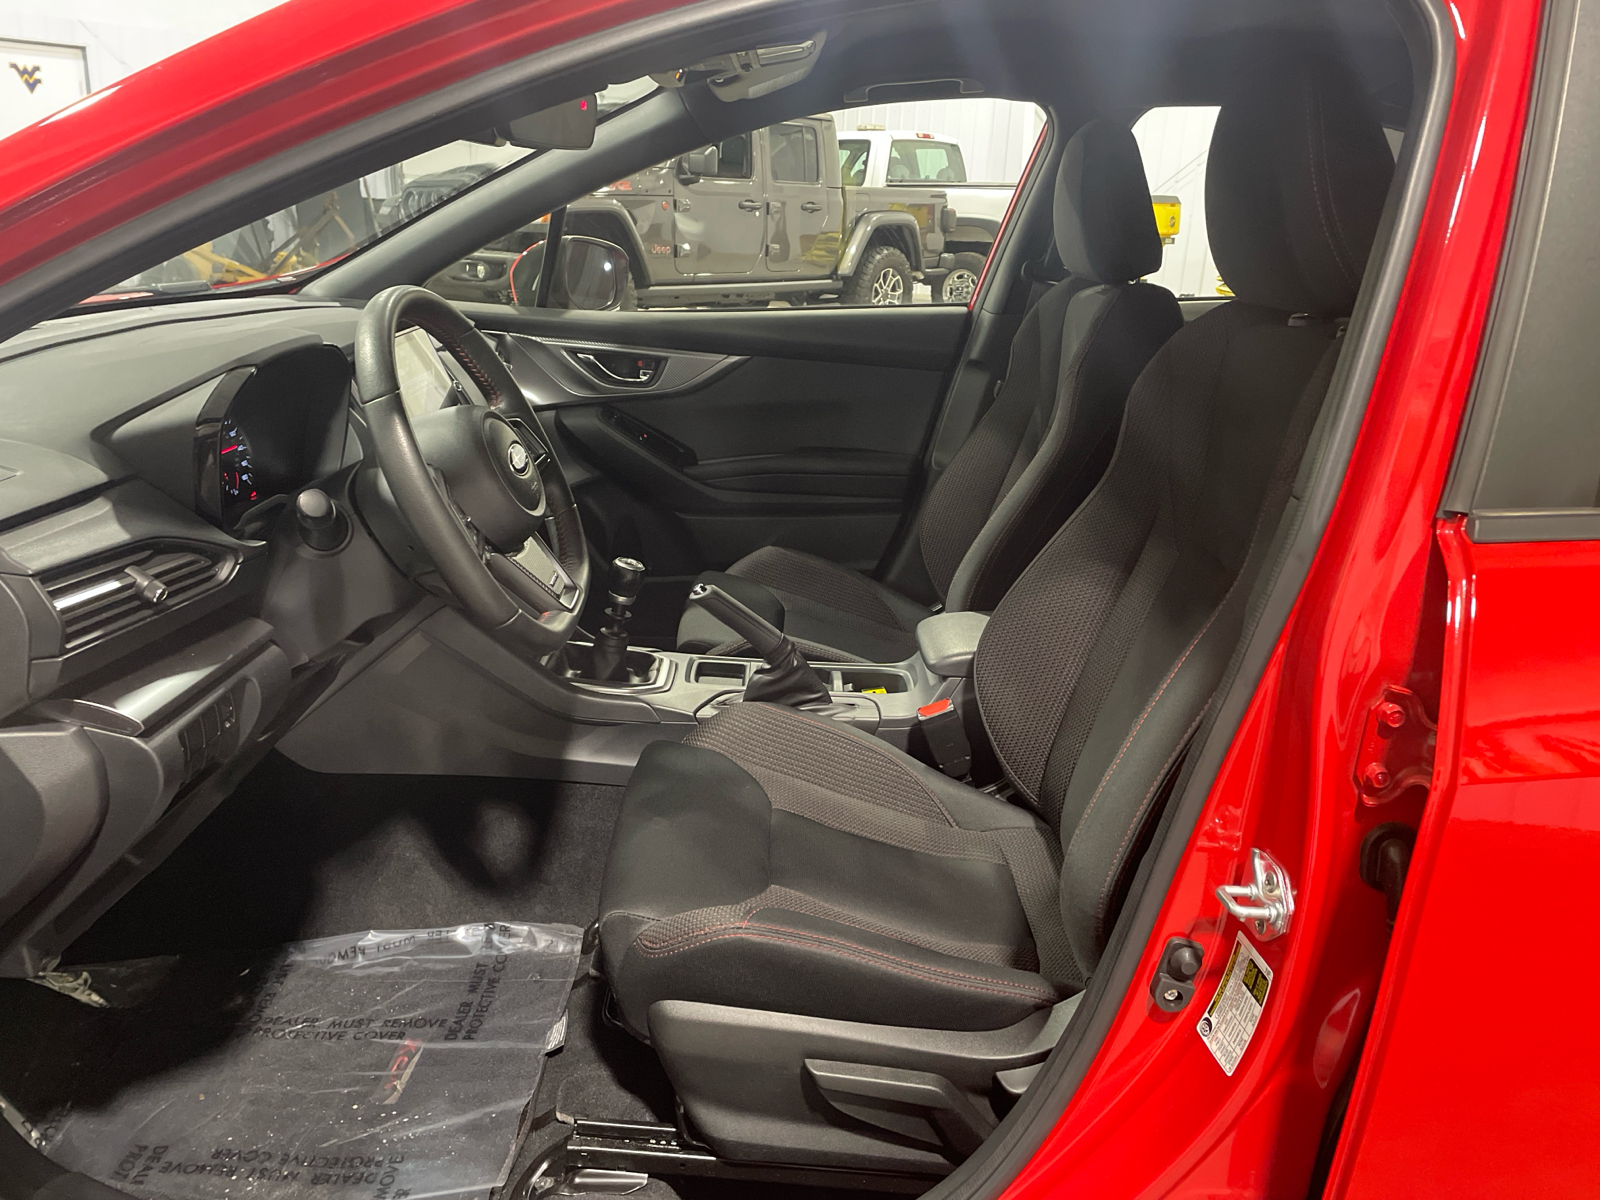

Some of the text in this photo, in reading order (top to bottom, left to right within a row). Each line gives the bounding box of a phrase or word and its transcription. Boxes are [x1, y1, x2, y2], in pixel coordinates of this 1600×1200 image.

[651, 244, 671, 255] Jeep
[461, 976, 502, 1041] PROTECTIVE
[491, 924, 511, 973] COER
[443, 961, 489, 1041] DEALER MUST
[264, 1016, 448, 1029] DEALER MUST REMOVE
[352, 1031, 407, 1041] COVER
[211, 1148, 384, 1169] PROTECTIVE COVER
[157, 1161, 239, 1179] REMOVE
[245, 1166, 301, 1183] MUST
[310, 1171, 379, 1186] DEALER
